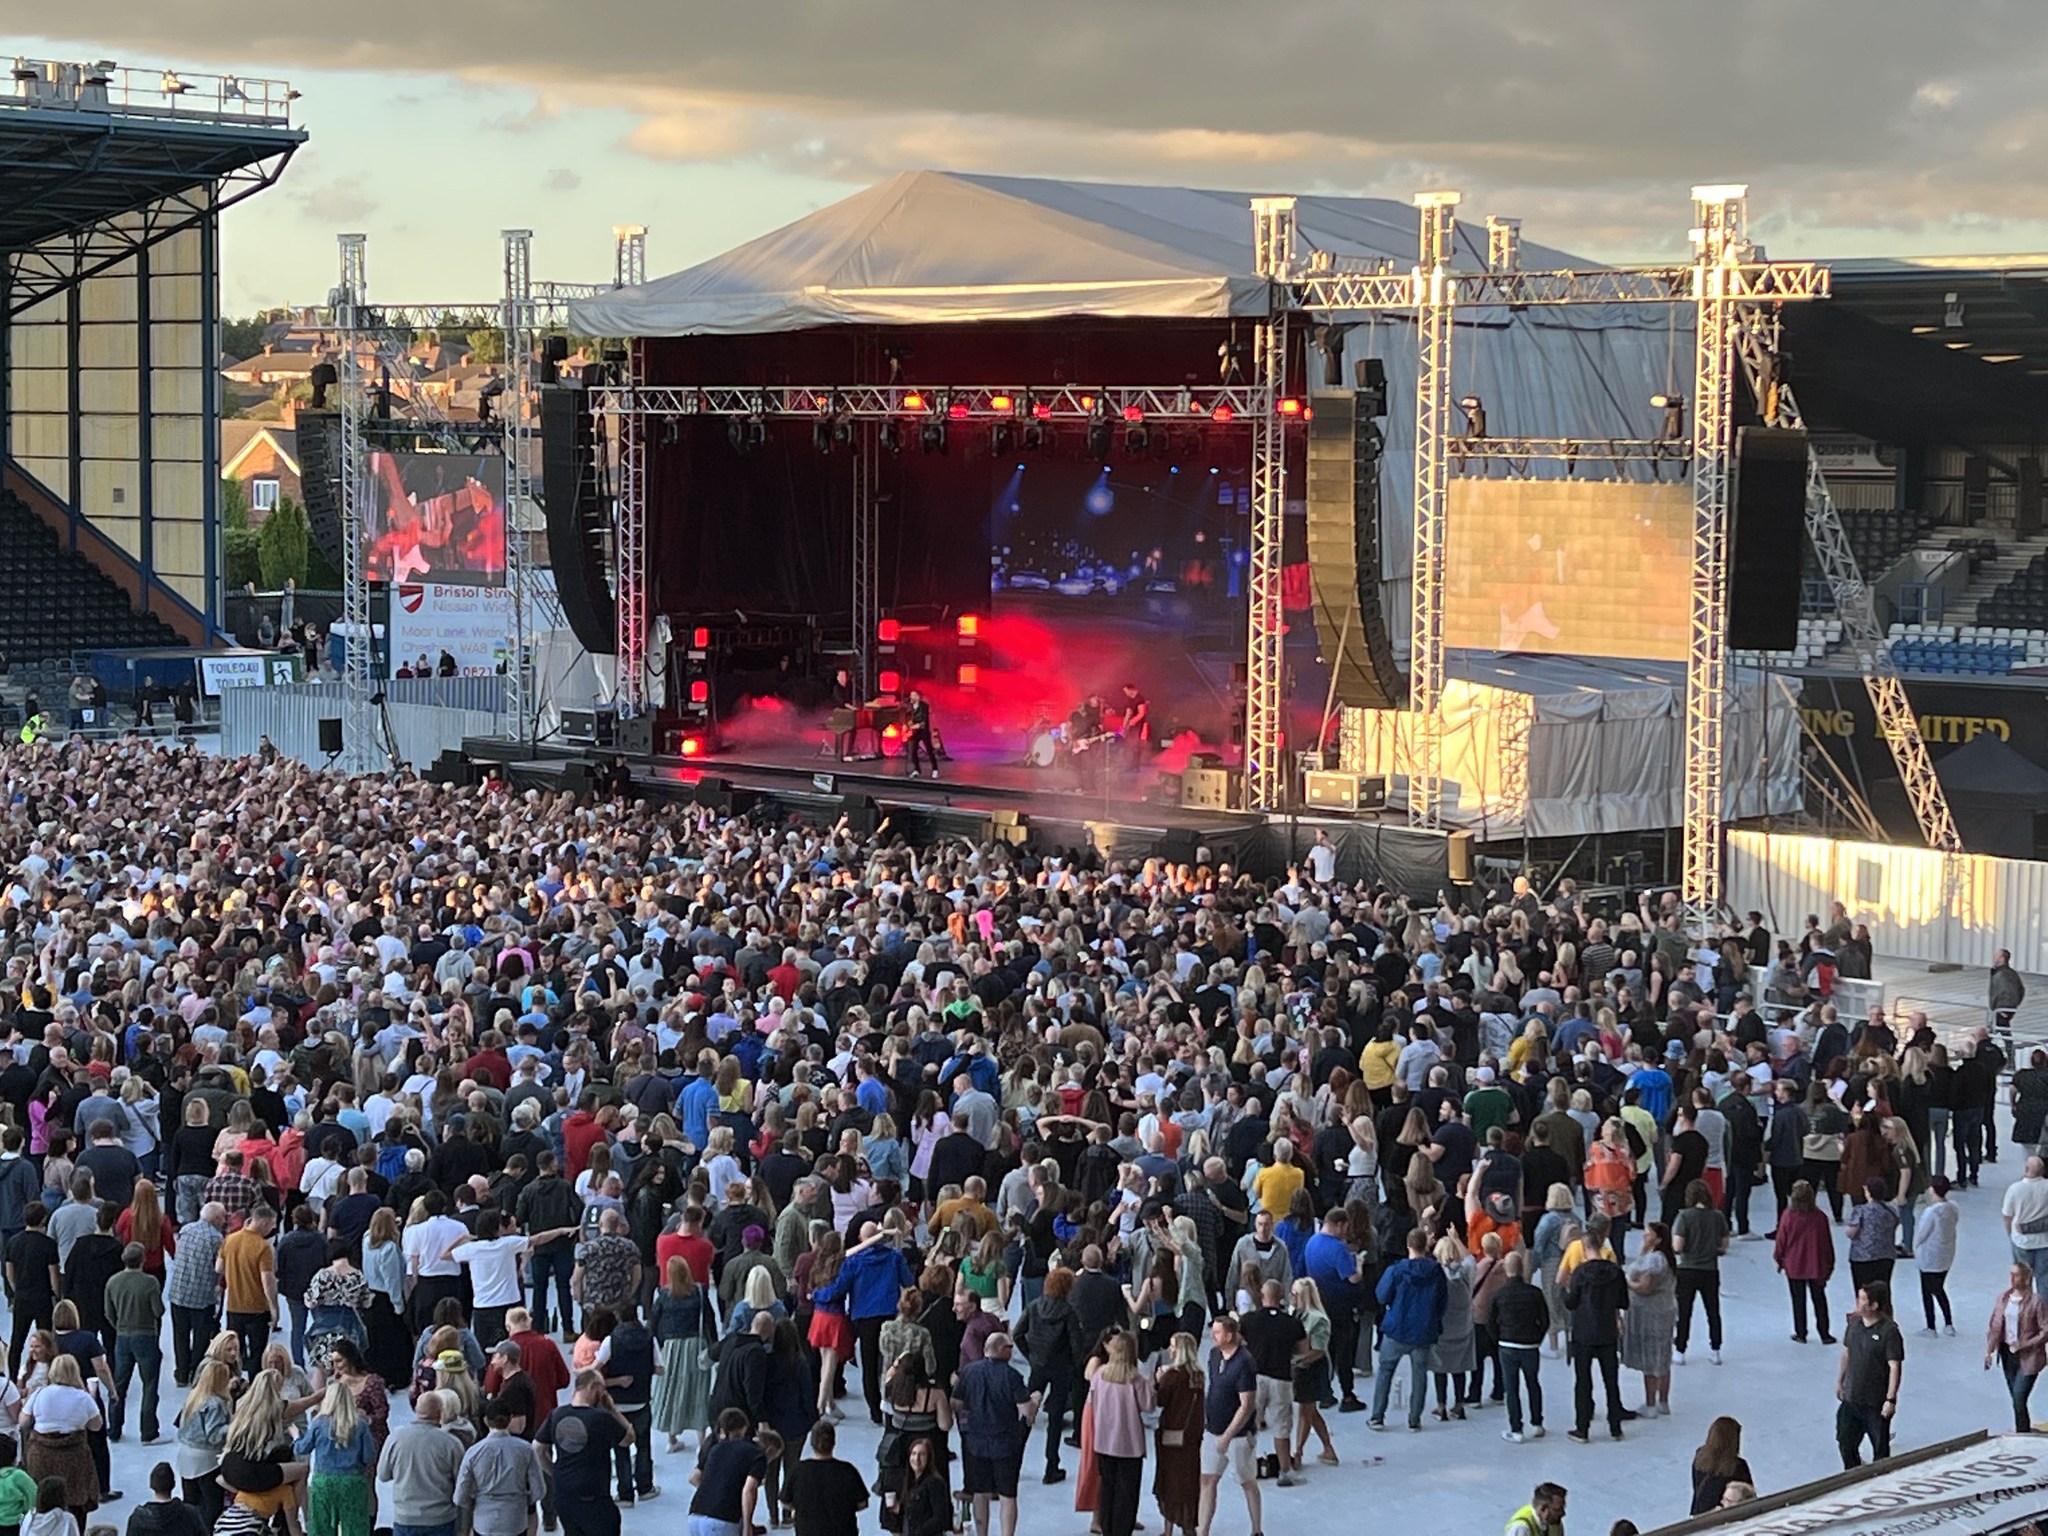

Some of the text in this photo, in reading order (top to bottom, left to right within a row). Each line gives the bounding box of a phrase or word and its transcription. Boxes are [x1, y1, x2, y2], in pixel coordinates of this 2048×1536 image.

[433, 586, 479, 598] Bristol
[484, 587, 524, 599] Strt
[432, 600, 478, 613] Nissan
[215, 678, 257, 689] TOILETS
